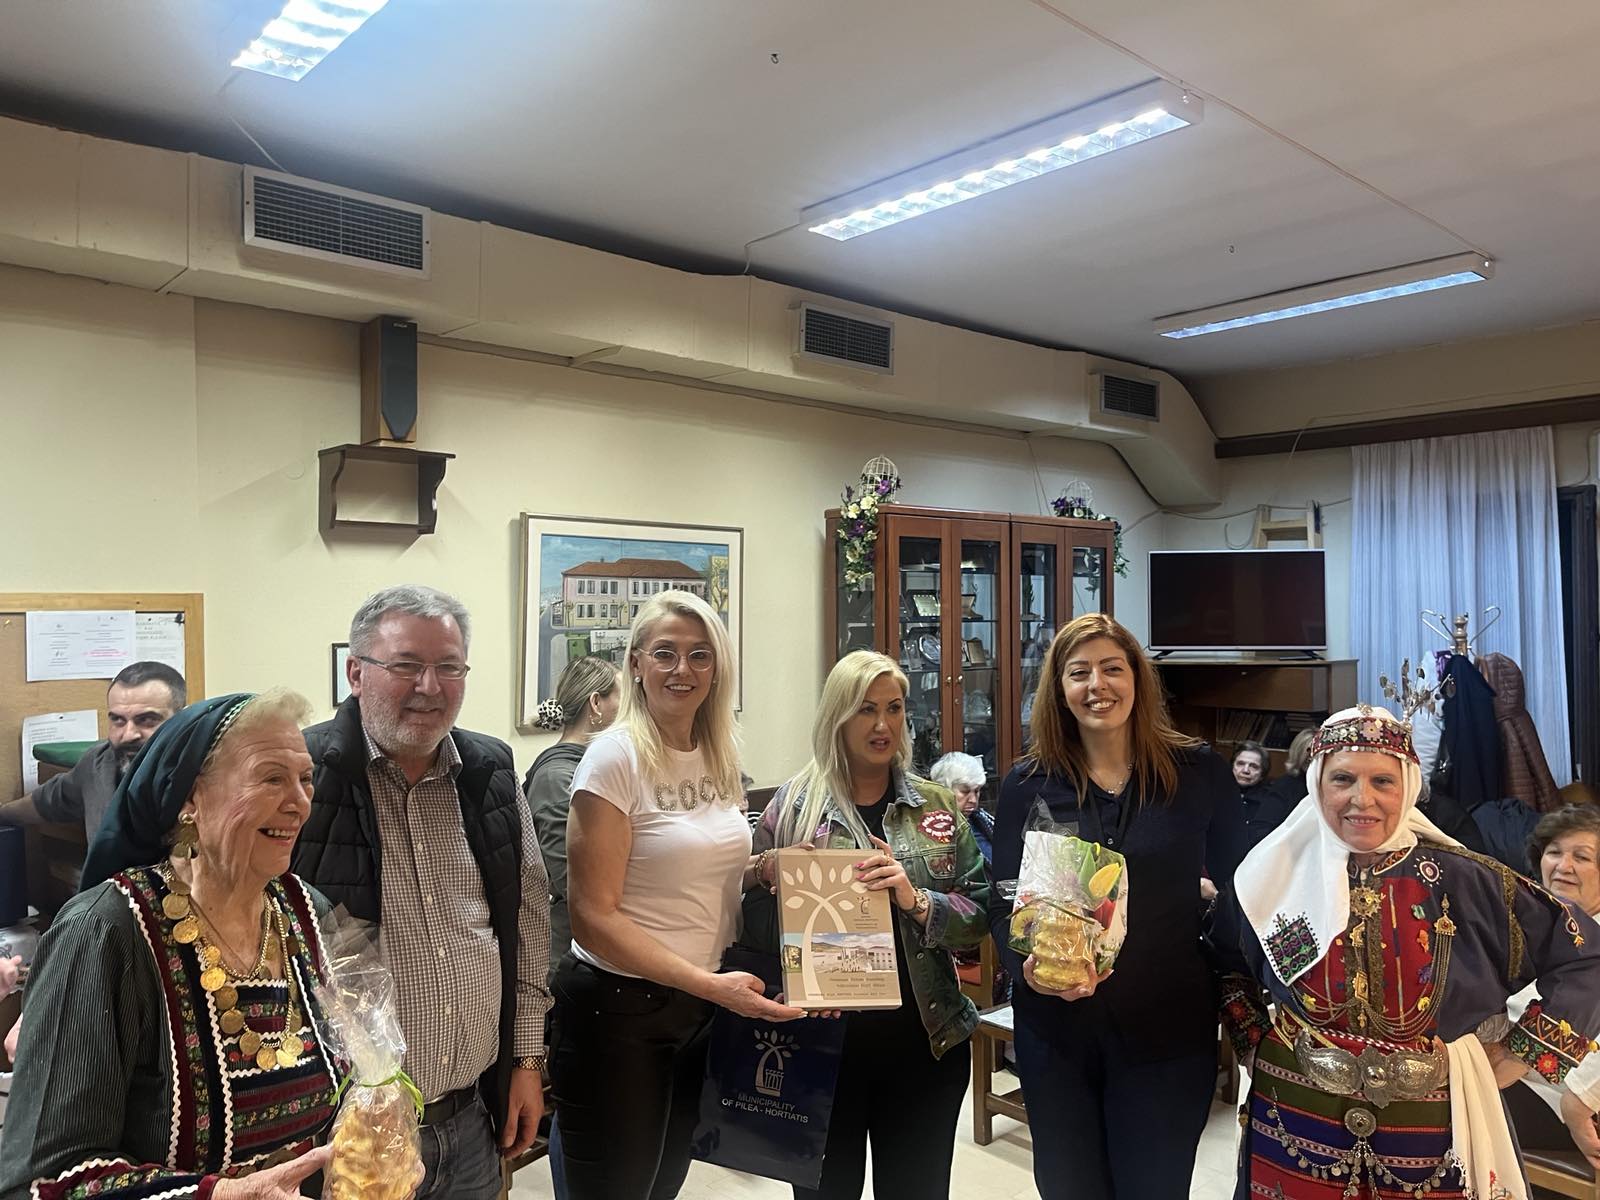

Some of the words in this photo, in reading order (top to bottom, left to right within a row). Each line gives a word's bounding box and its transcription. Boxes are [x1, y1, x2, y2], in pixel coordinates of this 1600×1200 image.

[722, 1098, 733, 1107] OF
[735, 1101, 759, 1112] PILEA
[765, 1107, 809, 1123] HORTIATIS
[738, 1093, 795, 1112] MUNICIPALITY
